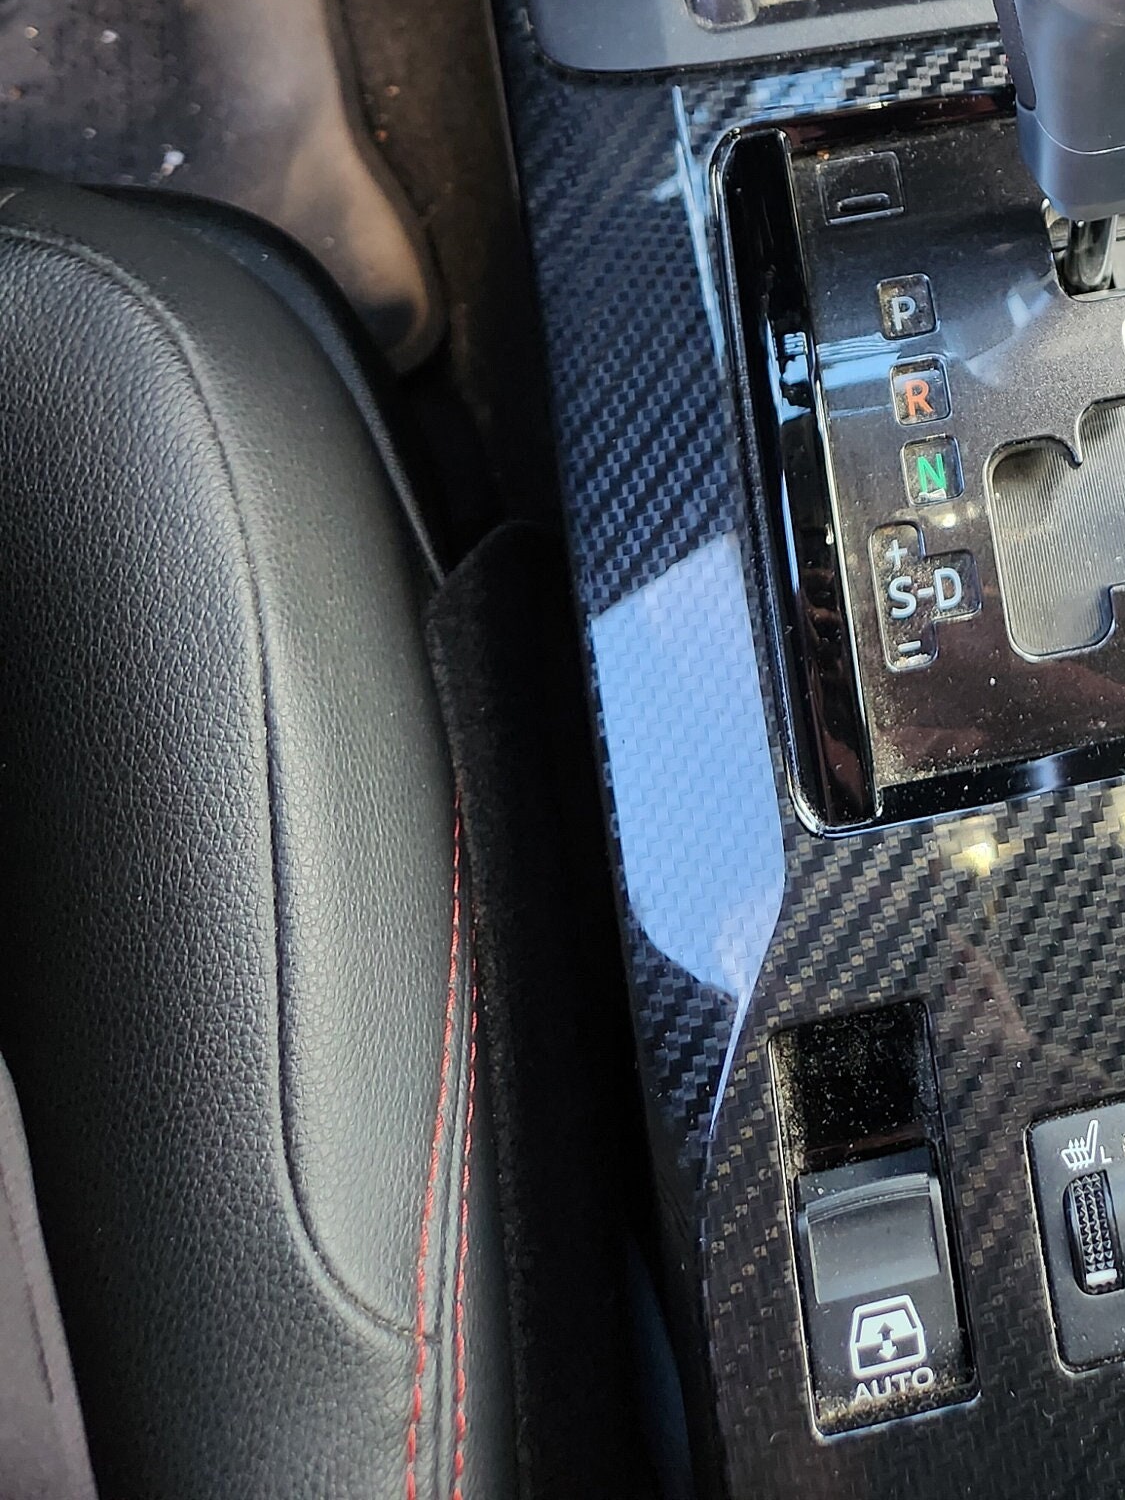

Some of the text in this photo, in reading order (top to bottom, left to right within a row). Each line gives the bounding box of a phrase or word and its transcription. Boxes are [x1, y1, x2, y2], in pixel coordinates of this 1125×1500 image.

[891, 296, 916, 330] P
[904, 378, 934, 417] R
[917, 453, 947, 493] N
[1099, 1145, 1112, 1164] L
[854, 1366, 935, 1405] AUTO
